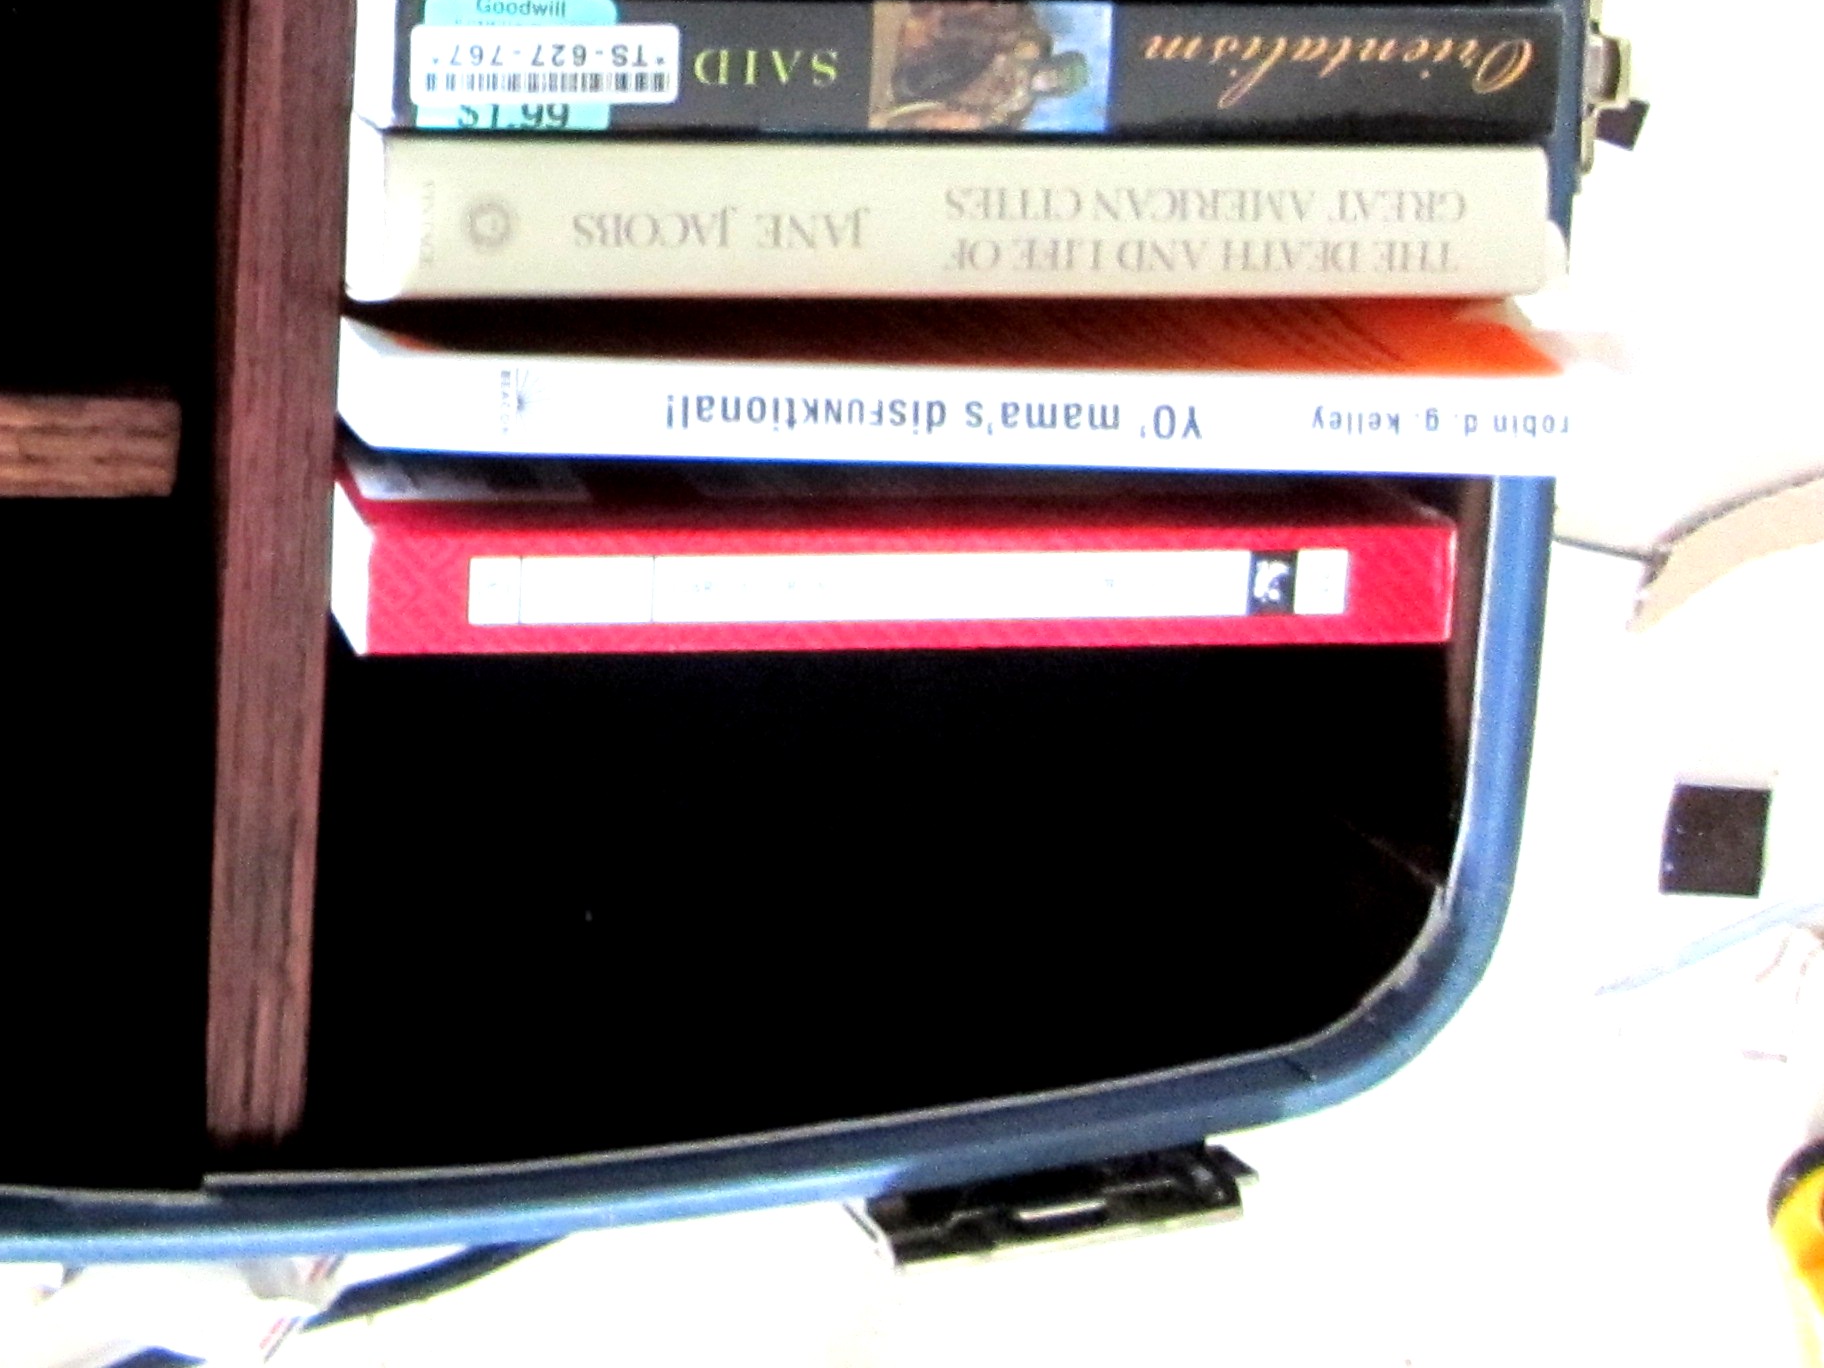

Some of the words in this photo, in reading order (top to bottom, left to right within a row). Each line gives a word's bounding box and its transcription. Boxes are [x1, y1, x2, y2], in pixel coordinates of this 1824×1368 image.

[692, 47, 840, 88] SAID
[1140, 33, 1535, 111] Orientalism
[942, 186, 1084, 222] CITIES
[1089, 186, 1316, 222] AMERICAN
[1327, 187, 1468, 224] GREAT
[570, 205, 737, 250] JACOBS
[755, 206, 871, 251] JANE
[947, 237, 1002, 272] OF
[1017, 237, 1105, 272] LIFE
[1117, 237, 1212, 272] AND
[1222, 237, 1361, 272] DEATH
[1374, 237, 1457, 273] THE
[964, 400, 1121, 438] mama's
[1138, 402, 1203, 441] YO'
[1311, 405, 1400, 438] kelley
[1414, 407, 1439, 433] g.
[1453, 412, 1479, 439] d.
[1492, 413, 1570, 440] robin
